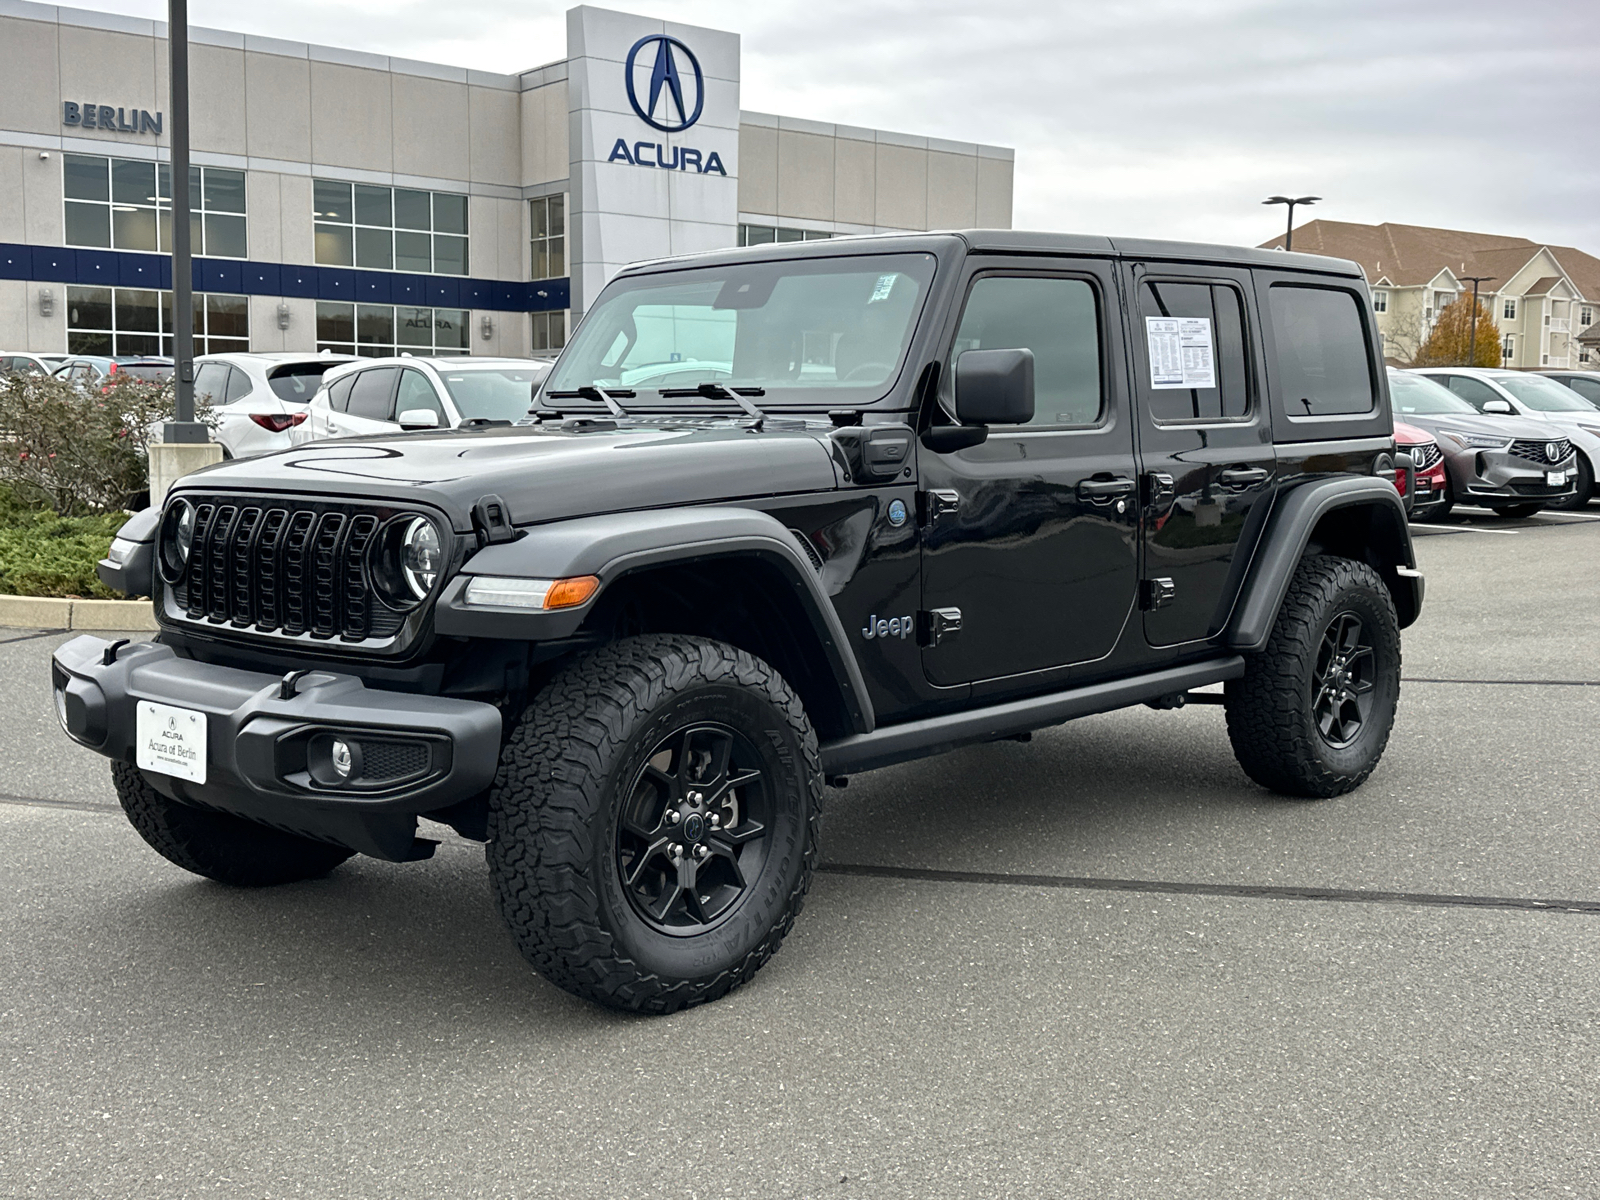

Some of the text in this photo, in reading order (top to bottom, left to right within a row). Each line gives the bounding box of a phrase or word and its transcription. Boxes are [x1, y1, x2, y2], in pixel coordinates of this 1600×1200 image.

[63, 101, 163, 135] BERLIN
[608, 138, 727, 176] ACURA
[862, 614, 914, 640] Jeep
[162, 730, 184, 741] ACURA
[148, 739, 167, 753] Acura
[168, 745, 176, 756] of
[177, 745, 197, 761] Berlin
